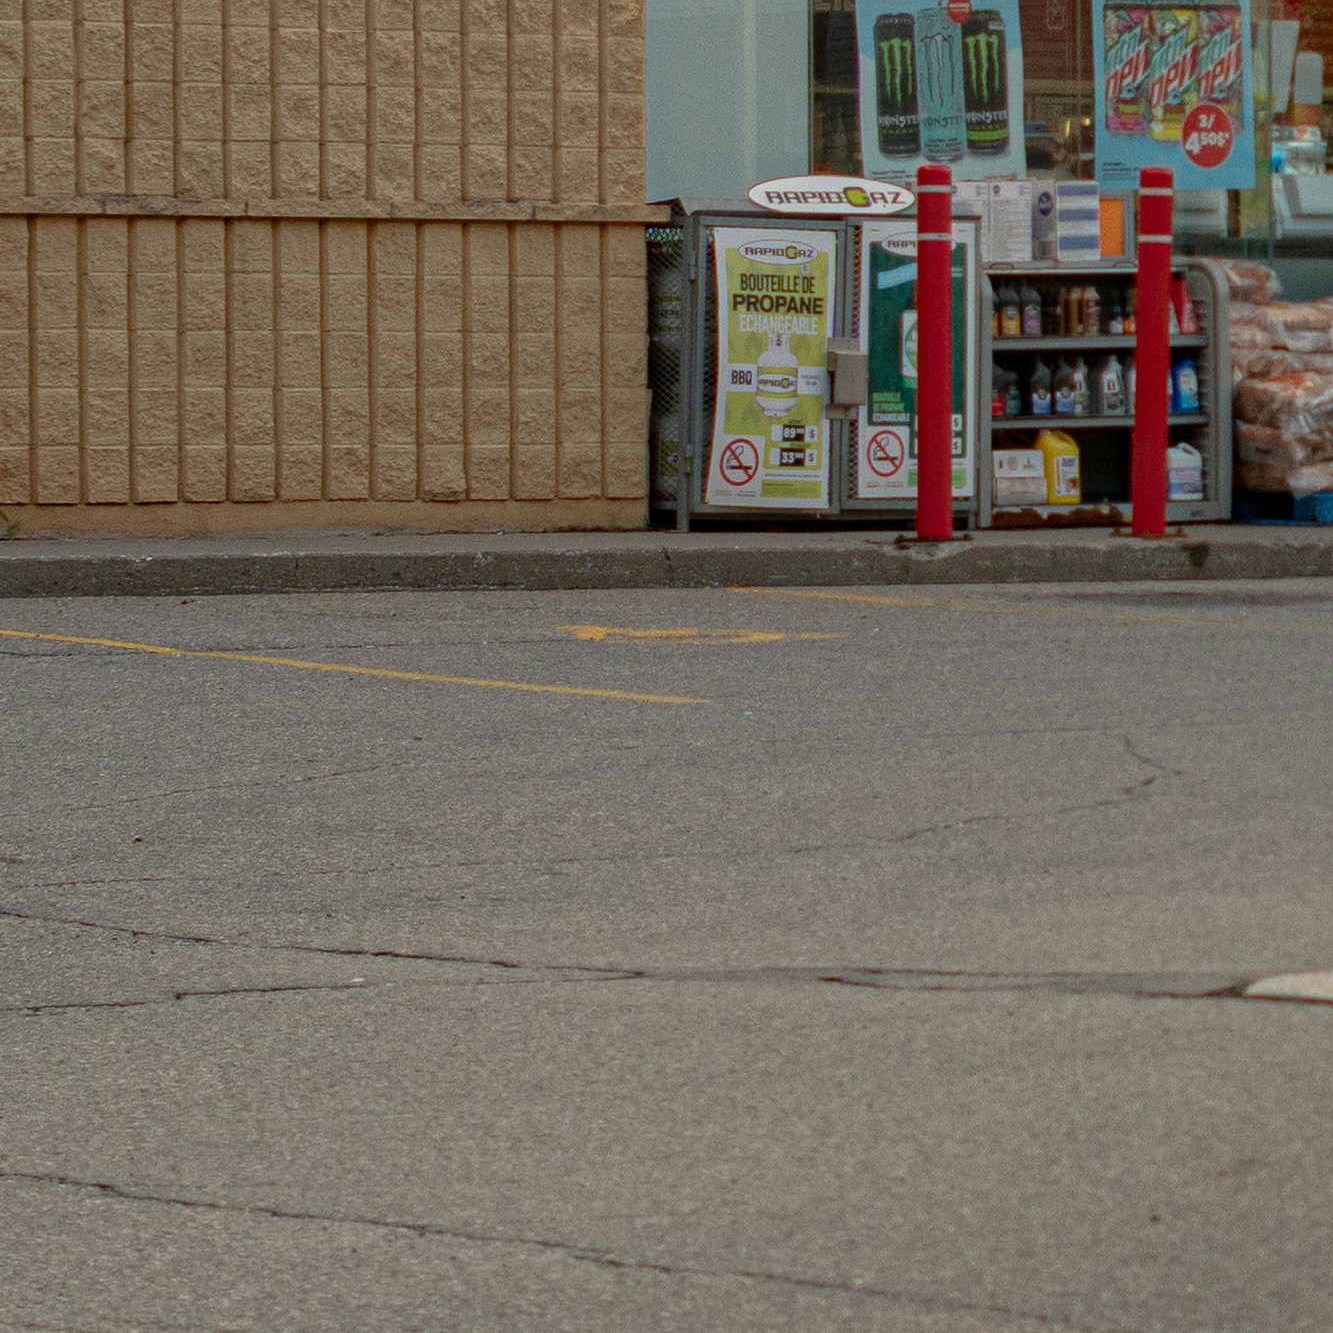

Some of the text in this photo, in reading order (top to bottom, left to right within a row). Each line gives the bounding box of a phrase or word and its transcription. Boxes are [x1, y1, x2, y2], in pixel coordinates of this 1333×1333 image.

[744, 245, 814, 260] RAPIDGAZ
[740, 273, 816, 294] BOUTEILLE DE
[732, 294, 824, 315] PROPANE
[731, 369, 753, 386] BBQ
